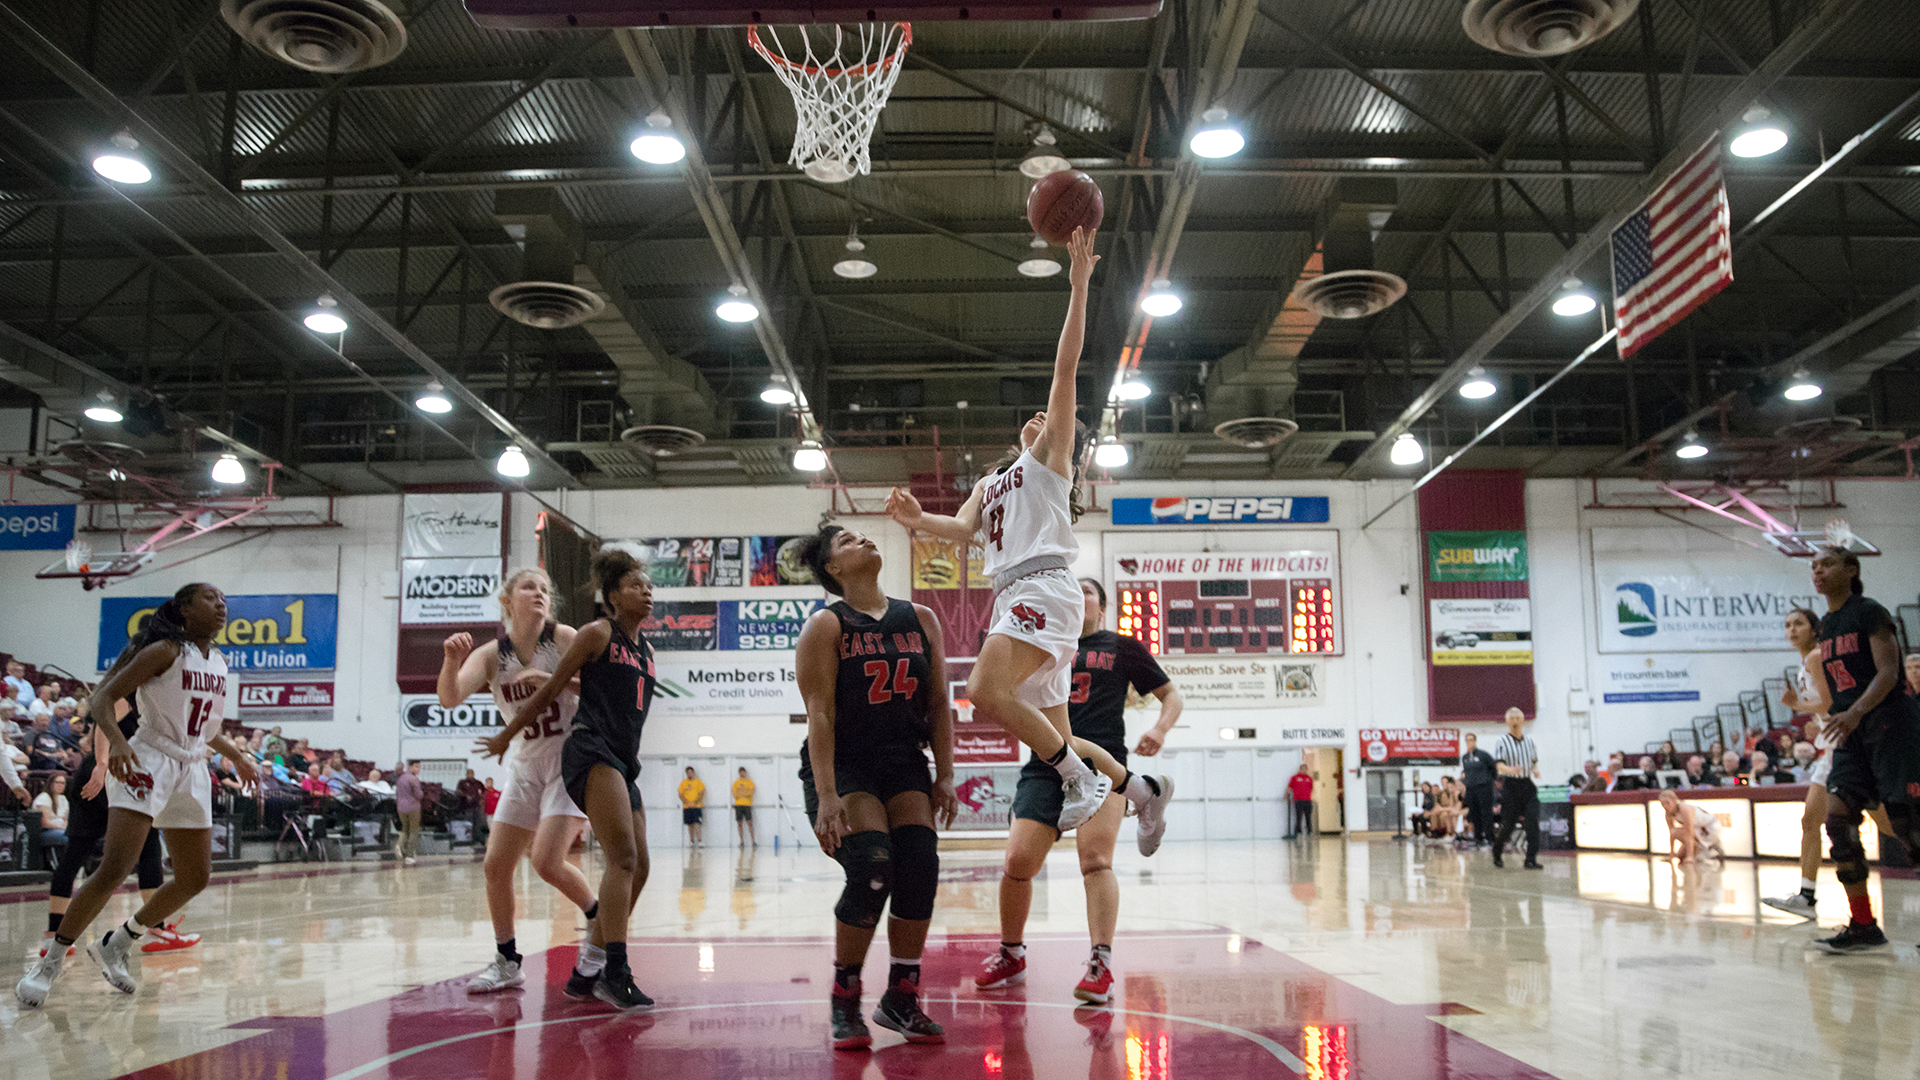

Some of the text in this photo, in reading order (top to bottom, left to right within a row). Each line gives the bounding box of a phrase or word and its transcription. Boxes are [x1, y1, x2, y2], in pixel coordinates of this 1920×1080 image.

[982, 466, 1023, 509] LDCATS
[1185, 498, 1293, 519] PEPSI
[990, 504, 1004, 552] 4
[692, 540, 714, 558] 24
[1438, 547, 1519, 564] SUBWAY
[1141, 557, 1328, 573] HOME OF THE WILDCATS!
[407, 575, 497, 599] MODERN
[738, 601, 816, 619] KPAY
[1255, 598, 1279, 607] GUEST
[738, 622, 801, 635] NEWS-TA
[1662, 621, 1731, 632] INSURANCE
[739, 635, 787, 649] 93.9
[840, 632, 886, 660] EAST
[254, 651, 307, 668] Union
[688, 668, 796, 684] Members 1s
[1164, 664, 1214, 676] Students
[1219, 664, 1246, 675] Save
[1611, 668, 1688, 680] tri counties bank
[863, 658, 918, 704] 24
[1179, 683, 1194, 692] Any
[241, 686, 285, 705] LRT
[636, 676, 645, 711] 1
[709, 687, 783, 698] Credit Union
[427, 703, 497, 727] STOTT
[1282, 728, 1345, 739] BUTTE STRONG
[1361, 729, 1458, 741] GO WILDCATS!
